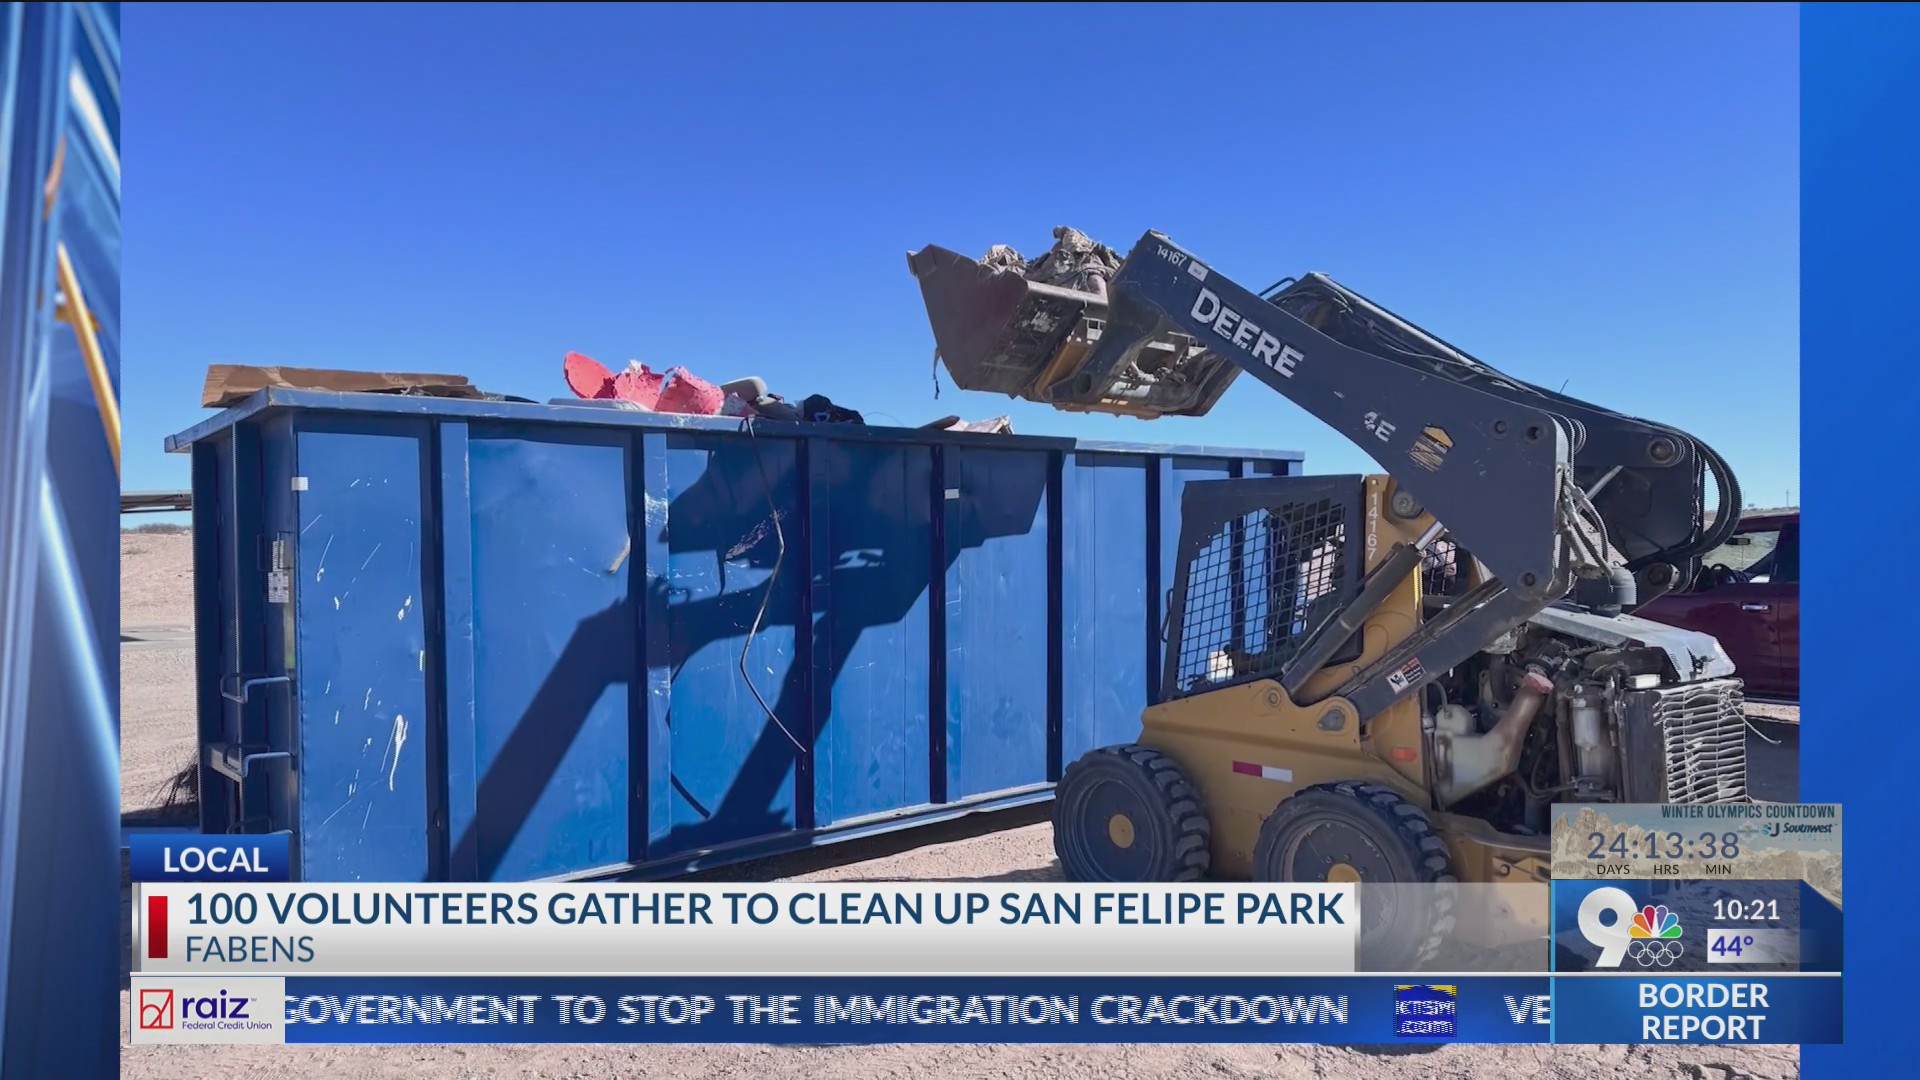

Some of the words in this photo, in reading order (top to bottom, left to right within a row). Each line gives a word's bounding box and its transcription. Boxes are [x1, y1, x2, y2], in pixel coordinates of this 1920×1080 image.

[1157, 244, 1188, 267] 14167
[1190, 286, 1305, 379] DEERE
[1367, 492, 1379, 561] 14167
